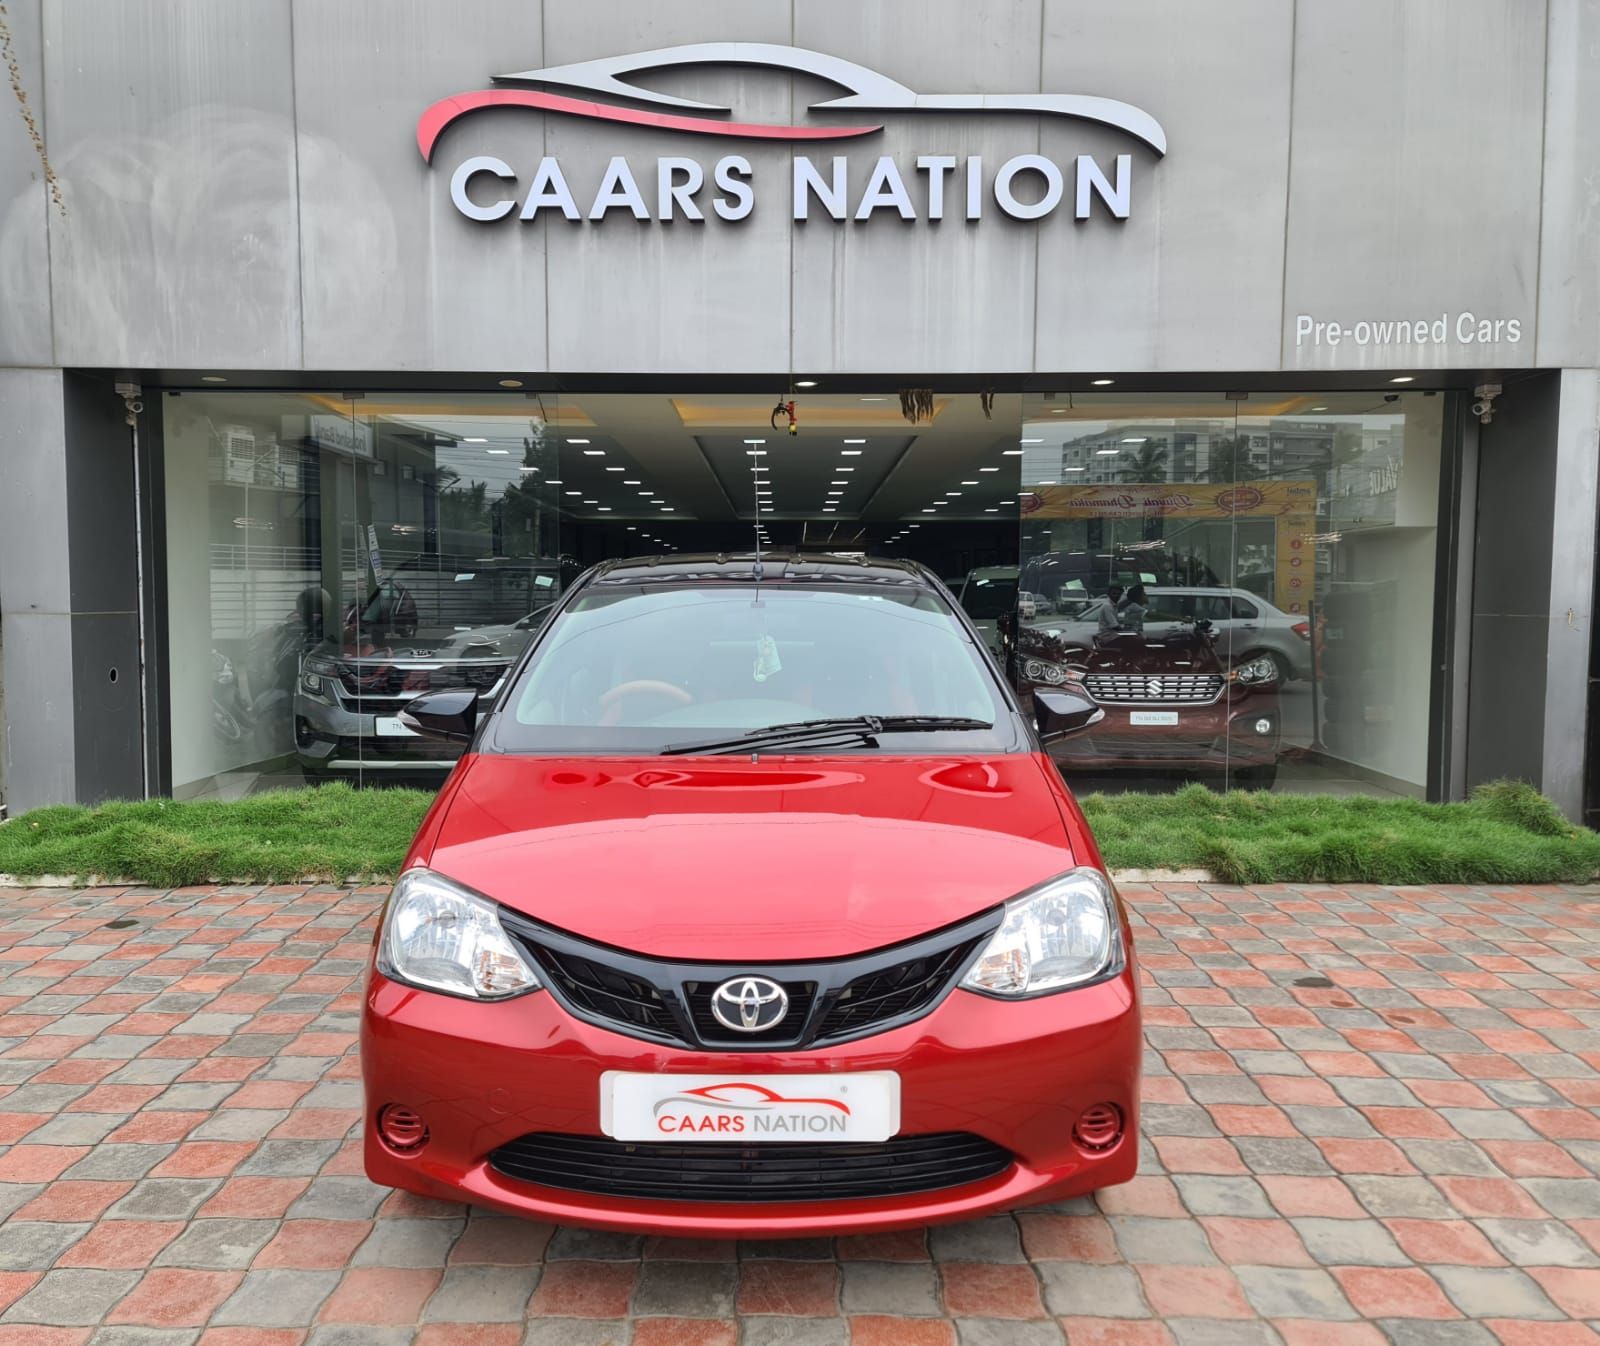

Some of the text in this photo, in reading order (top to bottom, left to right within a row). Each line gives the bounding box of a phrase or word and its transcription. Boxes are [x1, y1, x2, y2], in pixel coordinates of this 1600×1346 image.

[450, 154, 1132, 222] CAARS NATION
[1296, 311, 1521, 345] Pre-owned Cars
[658, 1115, 846, 1132] CAARS NATION
